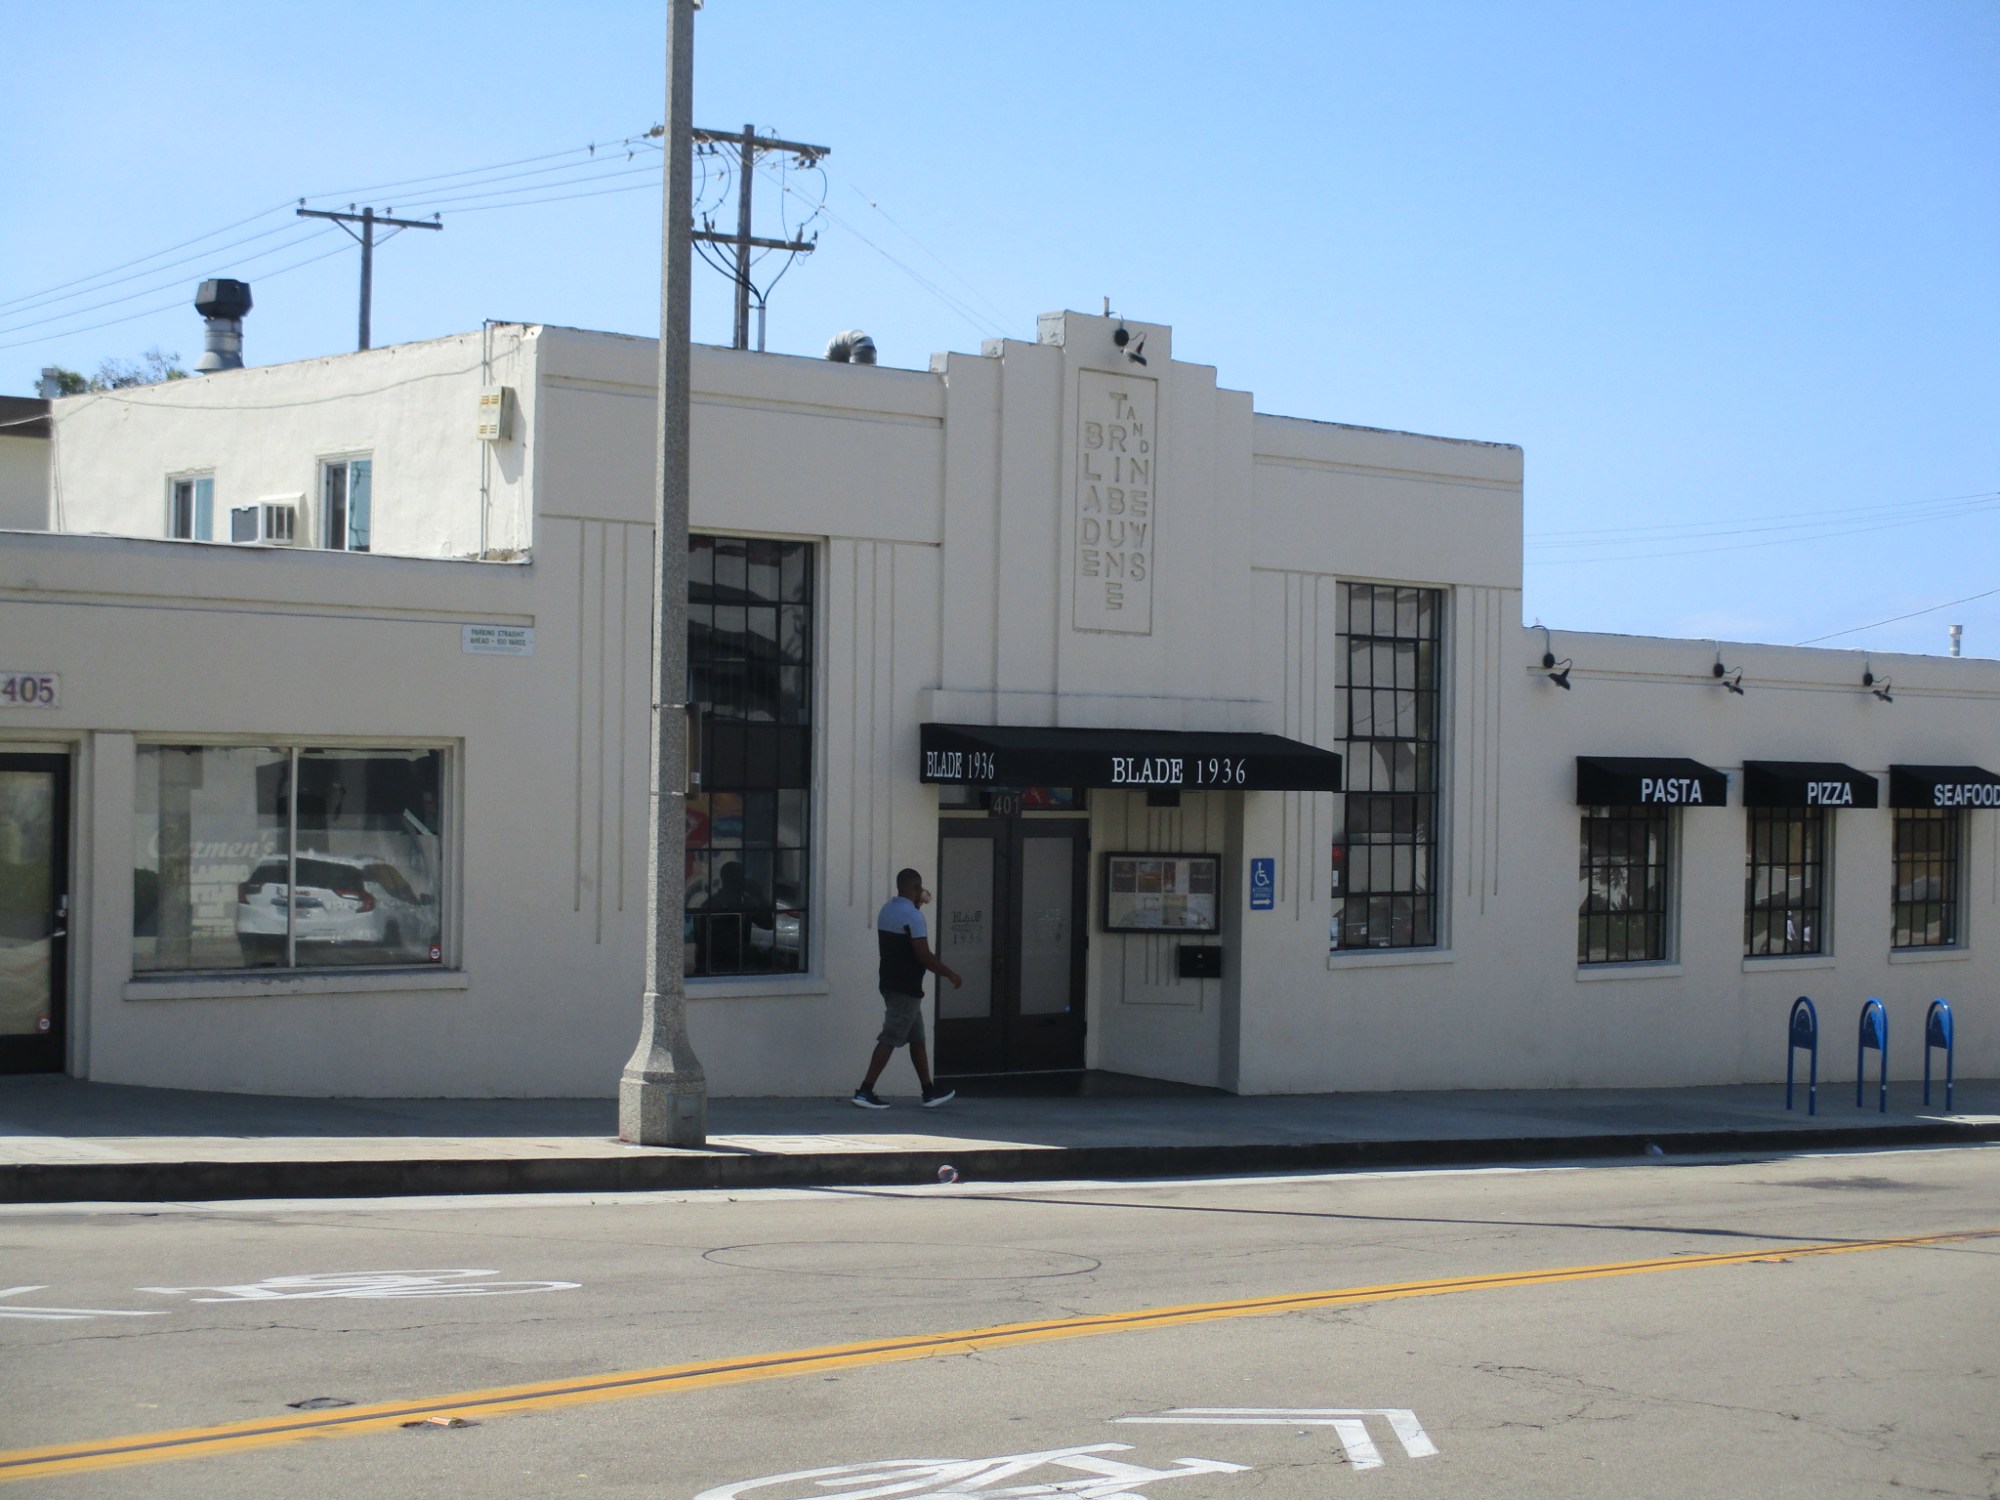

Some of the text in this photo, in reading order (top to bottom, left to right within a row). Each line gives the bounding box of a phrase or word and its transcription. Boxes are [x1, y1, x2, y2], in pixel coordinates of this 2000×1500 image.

[1082, 420, 1104, 577] BLADE
[1105, 392, 1128, 611] TRIBUNE
[470, 637, 490, 645] AHEAD
[508, 639, 527, 647] YARDS
[471, 628, 526, 638] PARKING STRAIGHT
[2, 677, 54, 703] 405
[926, 751, 995, 780] BLADE 1936
[1111, 757, 1246, 784] BLADE 1936
[1641, 777, 1703, 803] PASTA
[1807, 782, 1853, 805] PIZZA
[1933, 783, 2000, 807] SEAFOOD
[993, 795, 1020, 815] 401
